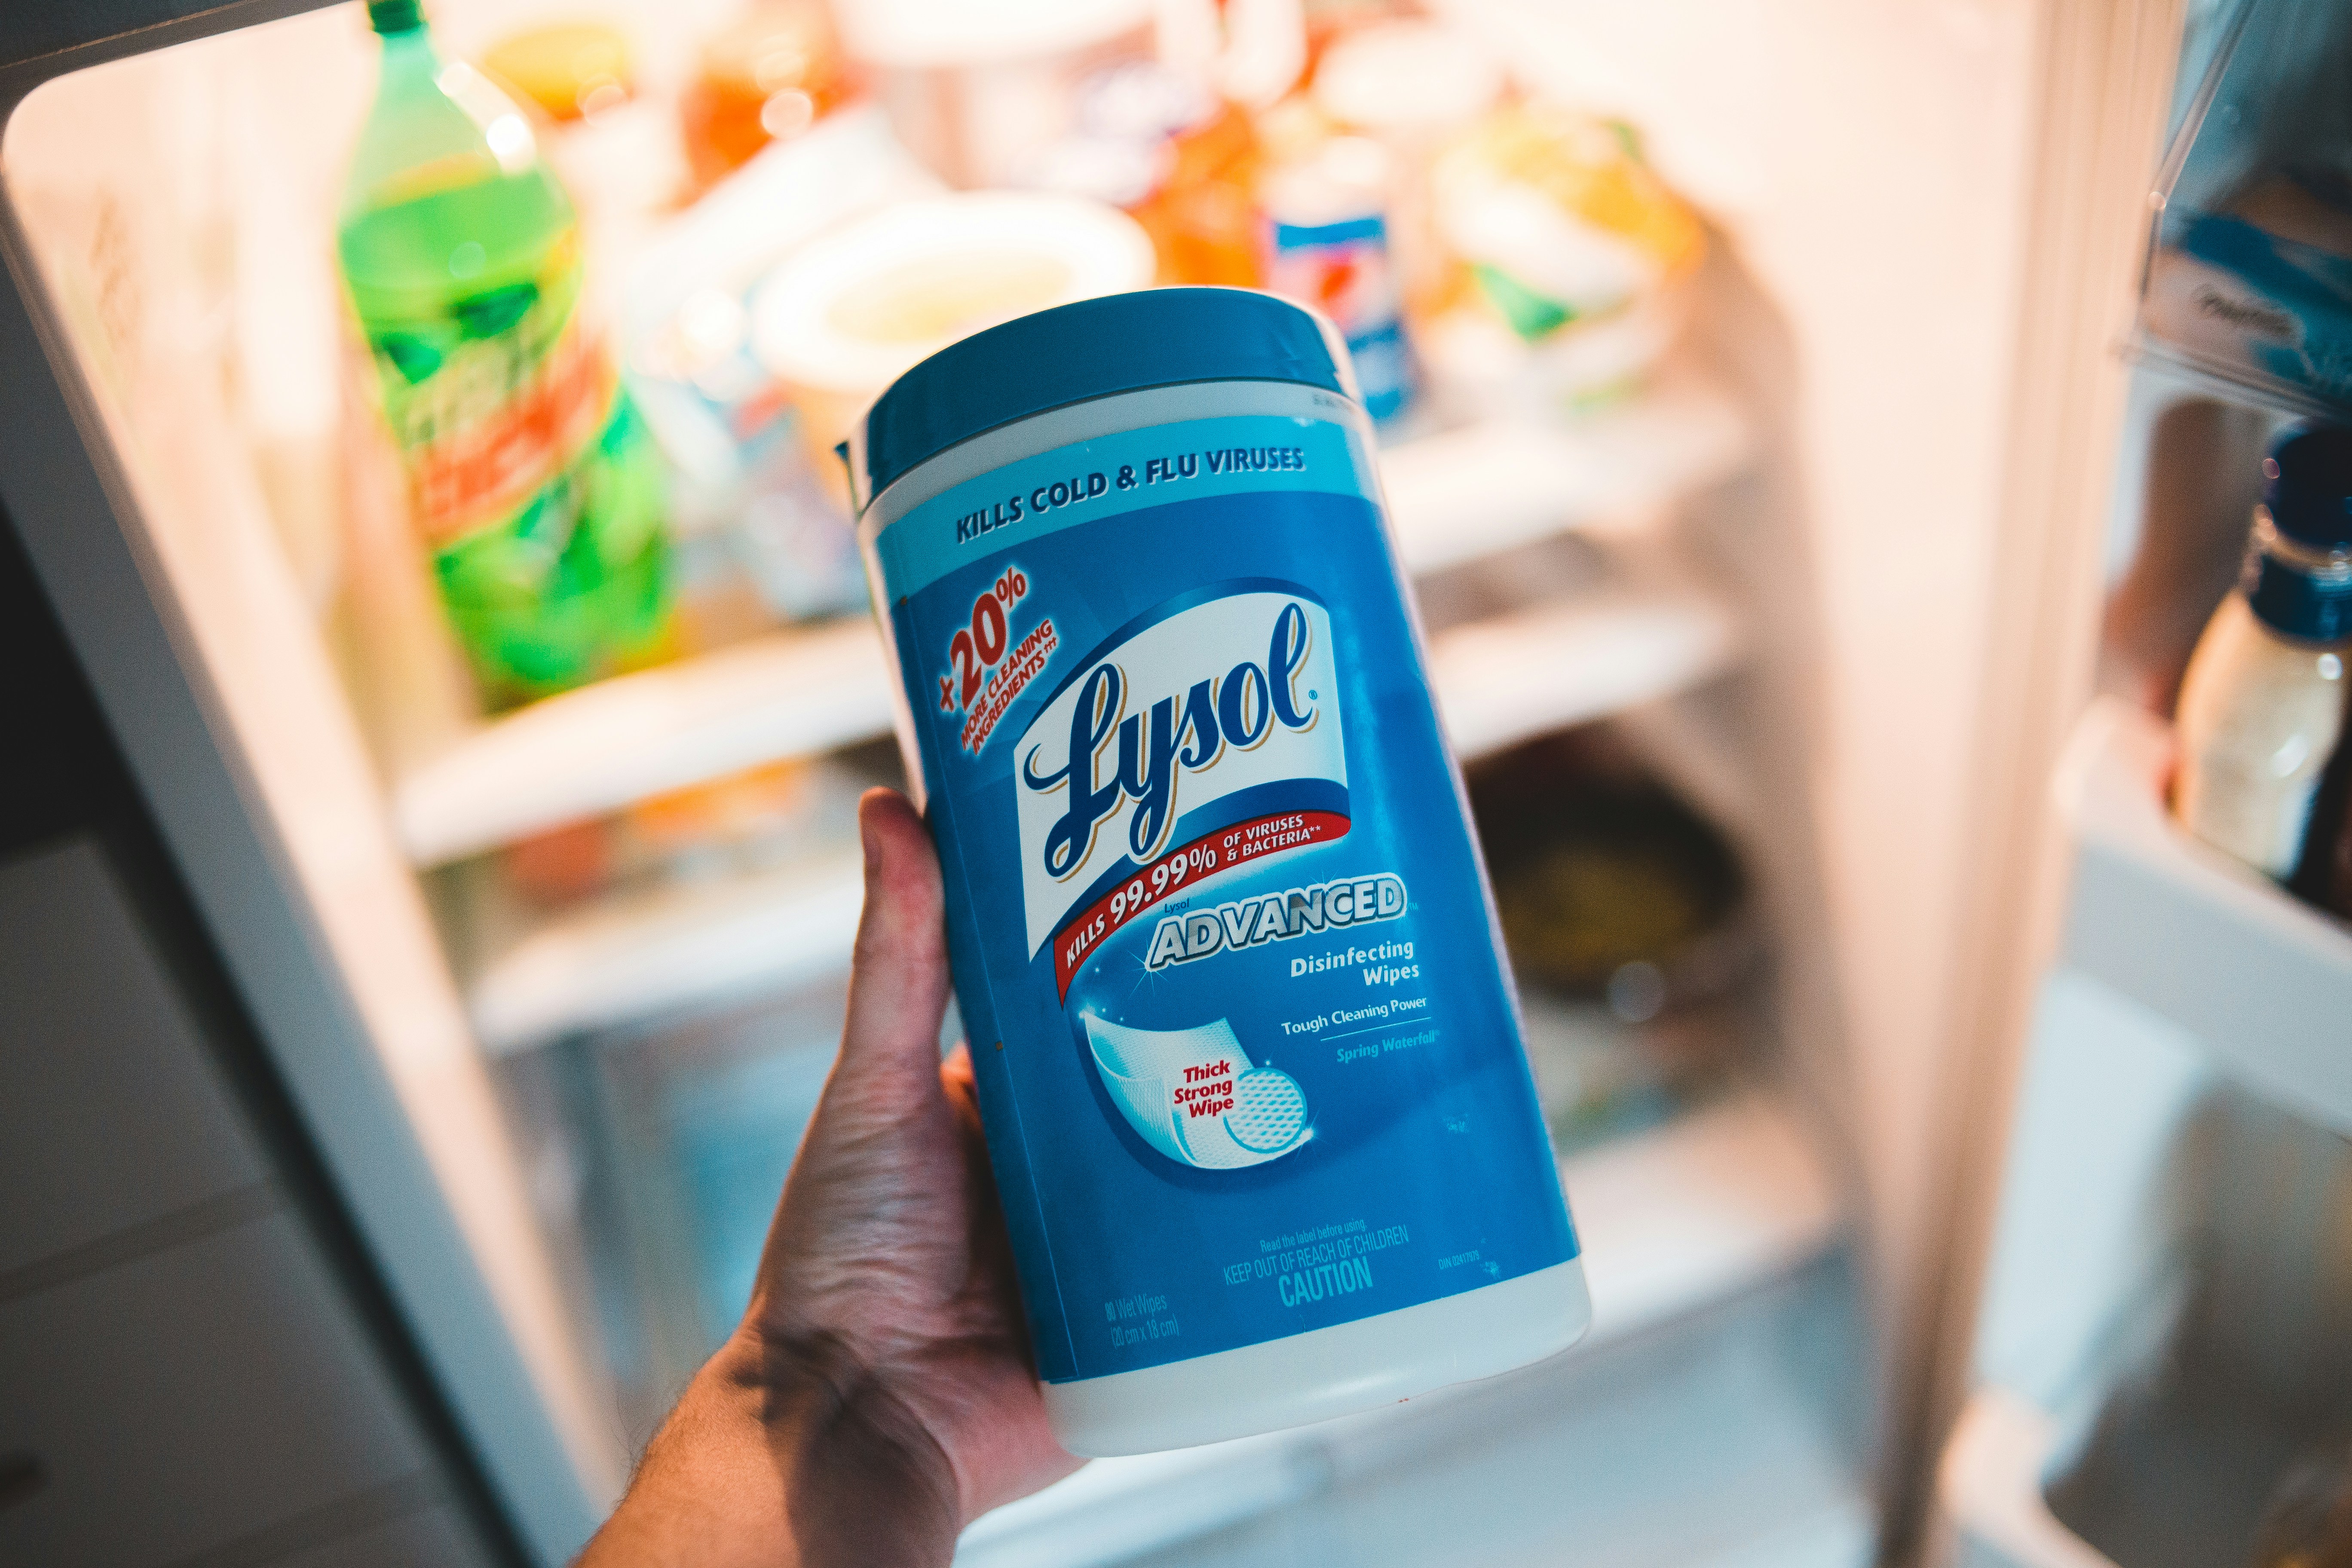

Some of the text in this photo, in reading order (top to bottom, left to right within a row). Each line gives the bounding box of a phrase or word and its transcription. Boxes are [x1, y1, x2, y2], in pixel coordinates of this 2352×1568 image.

[956, 447, 1306, 545] KILLS COLD & FLU VIRUSES
[961, 619, 1053, 751] MORE CLEANING
[1223, 815, 1303, 849] OF VIRUSES
[1227, 849, 1237, 861] &
[1066, 844, 1216, 969] KILLS 99.99%
[1164, 898, 1190, 914] Lysol
[1291, 940, 1414, 977] Disinfecting
[1363, 965, 1419, 986] Wipes
[1281, 997, 1427, 1035] Tough Cleaning Power
[1337, 1044, 1378, 1063] Spring
[1183, 1060, 1230, 1083] Thick
[1174, 1080, 1232, 1104] Strong
[1189, 1098, 1234, 1118] Wipe
[1260, 1239, 1281, 1253] Read
[1282, 1235, 1295, 1247] the
[1295, 1228, 1316, 1244] label
[1317, 1224, 1343, 1239] before
[1223, 1225, 1409, 1285] KEEP OUT OF REACH OF CHILDREN
[1438, 1258, 1452, 1270] DIN
[1278, 1256, 1372, 1307] CAUTION
[1116, 1298, 1136, 1319] Wet
[1134, 1293, 1167, 1316] Wipes
[1125, 1328, 1139, 1344] cm
[1140, 1326, 1147, 1341] x
[1147, 1319, 1159, 1339] 18
